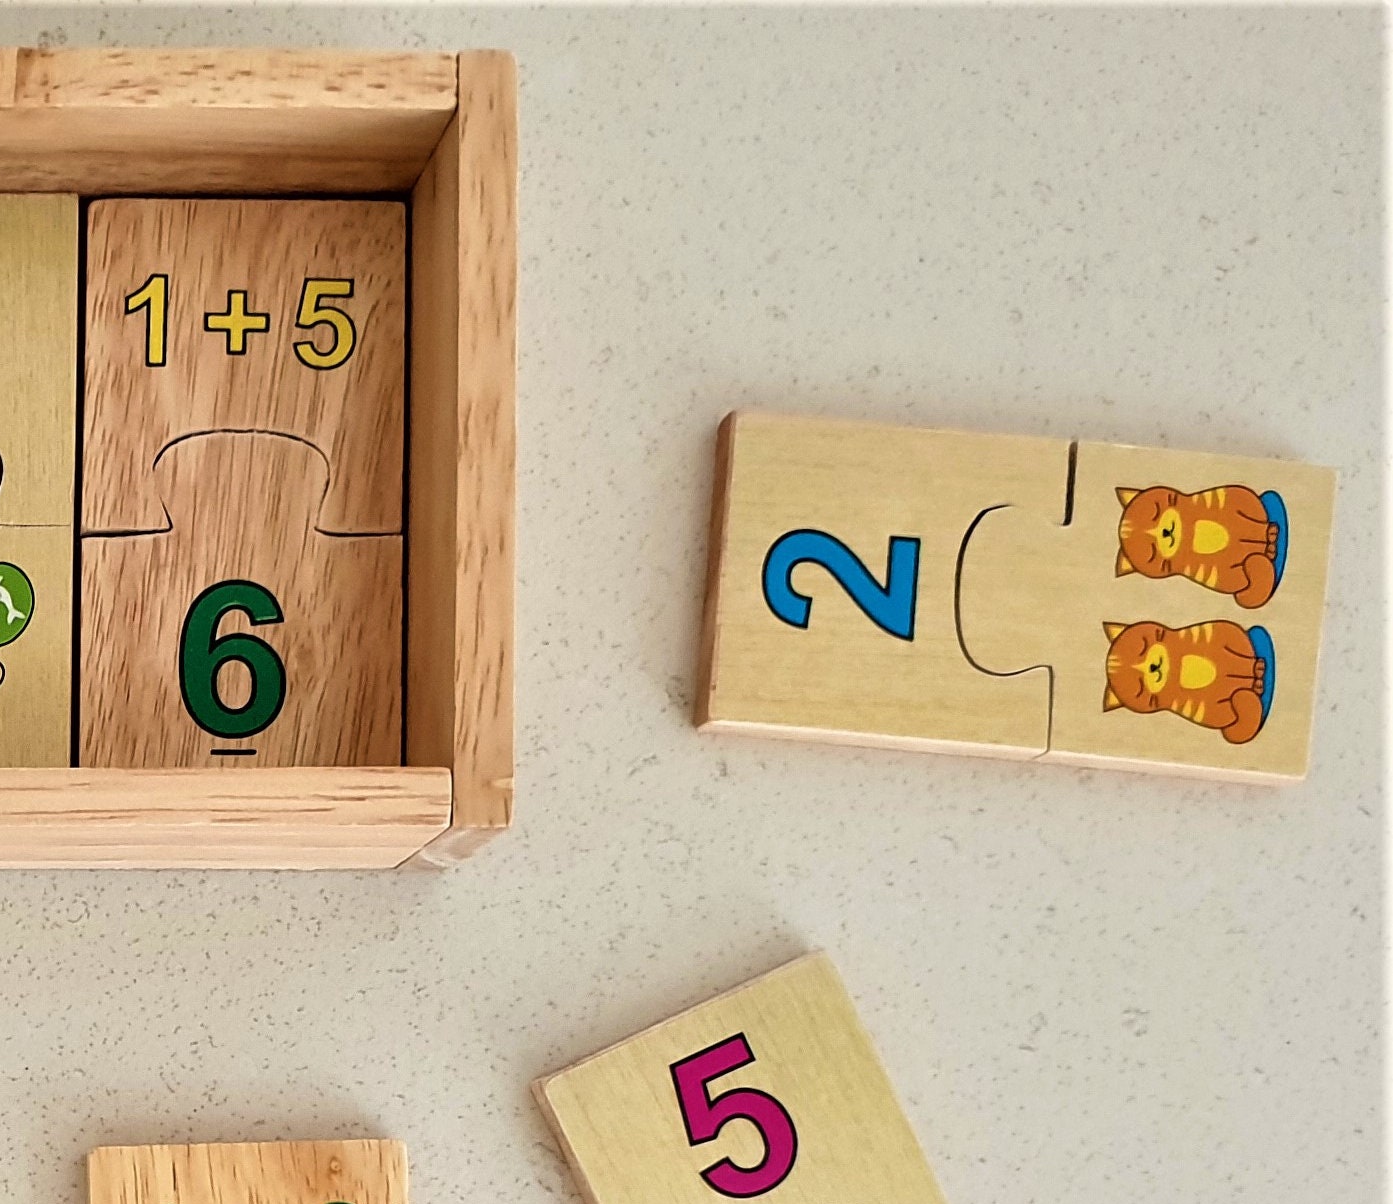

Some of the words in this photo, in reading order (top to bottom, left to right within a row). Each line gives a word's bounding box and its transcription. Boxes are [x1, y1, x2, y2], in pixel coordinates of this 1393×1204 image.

[179, 579, 287, 739] 6
[761, 528, 922, 642] 2
[669, 1032, 799, 1199] 5
